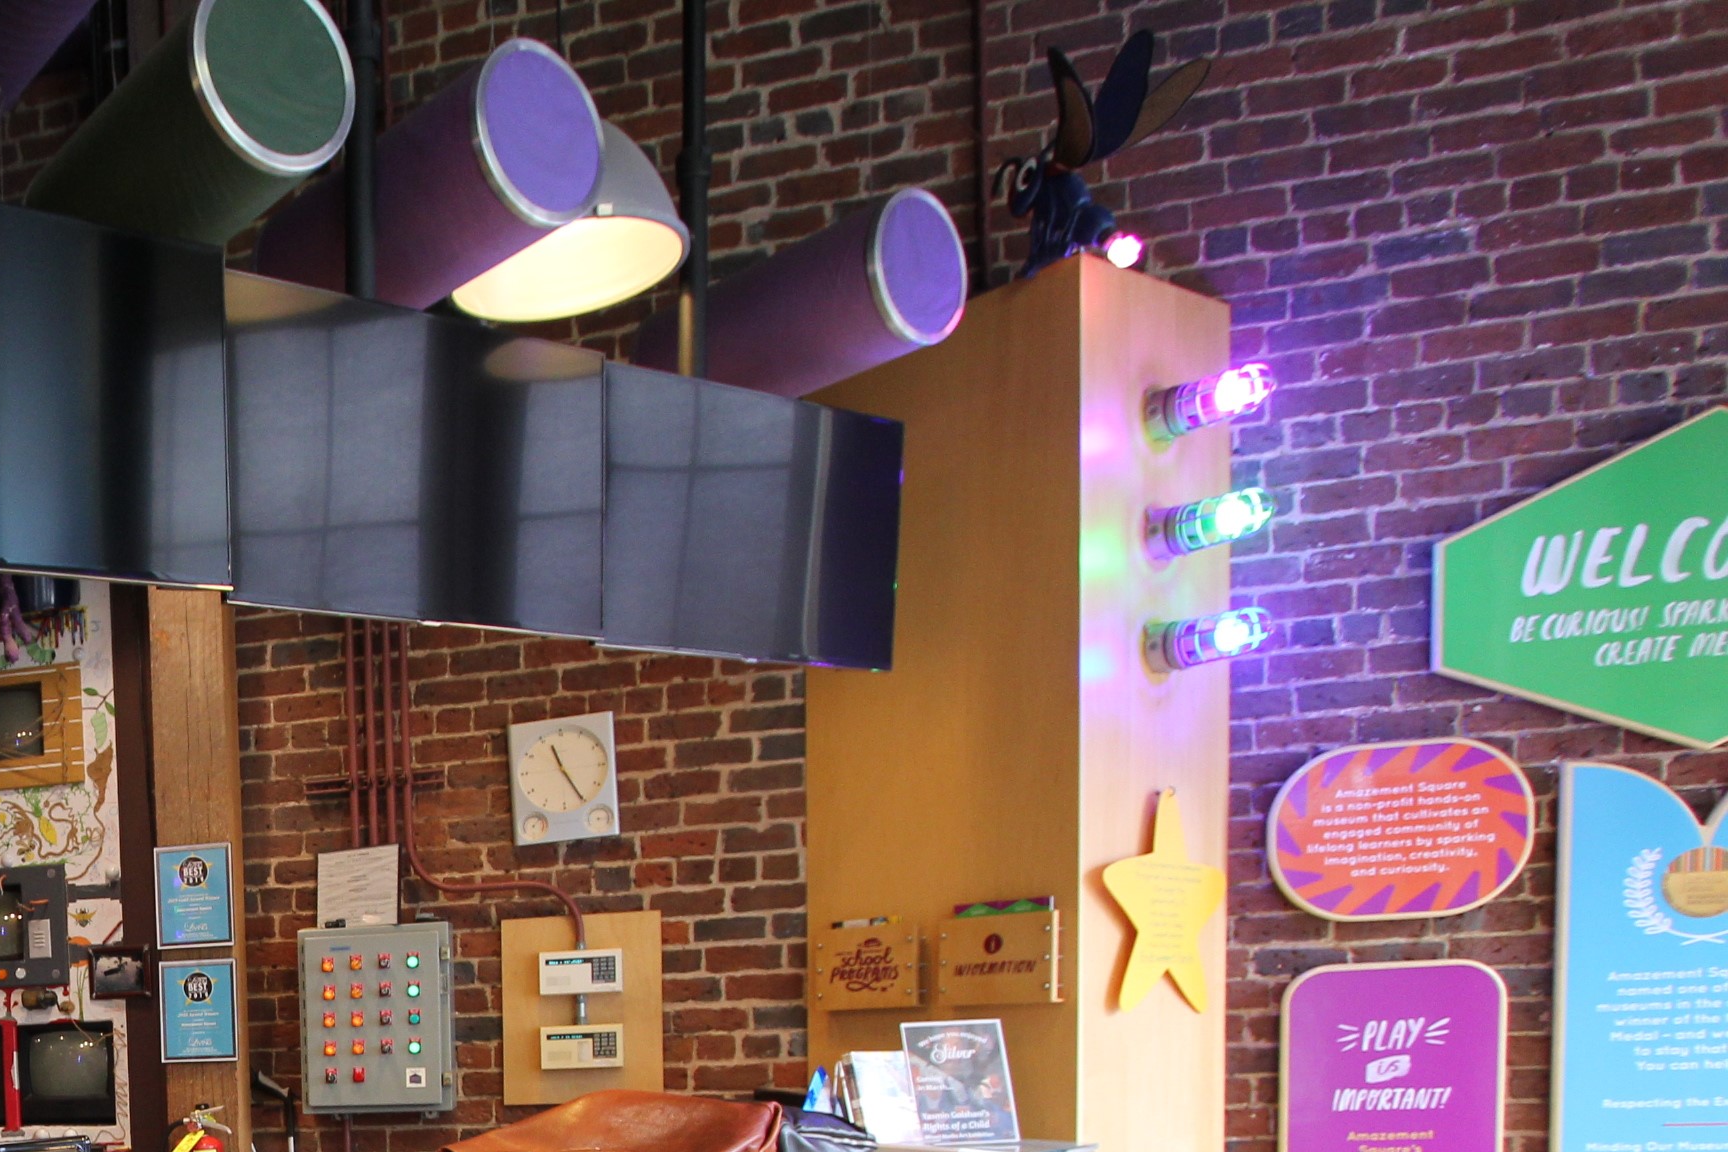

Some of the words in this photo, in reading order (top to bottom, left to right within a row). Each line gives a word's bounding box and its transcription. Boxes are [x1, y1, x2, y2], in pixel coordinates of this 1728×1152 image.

[1510, 615, 1540, 643] BE
[1541, 605, 1650, 641] CURIOUS!
[1594, 634, 1683, 668] CREATE
[1335, 783, 1414, 799] Amazement
[1418, 780, 1467, 793] Square
[1321, 804, 1332, 813] is
[1334, 804, 1344, 812] a
[1347, 797, 1414, 811] non-profit
[1418, 793, 1481, 805] hands-on
[1312, 814, 1368, 827] museum
[1372, 811, 1399, 822] that
[1403, 807, 1468, 821] cultivates
[1471, 805, 1489, 814] an
[1323, 827, 1382, 840] engaged
[1386, 821, 1460, 835] community
[1464, 818, 1480, 829] of
[1306, 841, 1354, 854] lifelong
[1358, 837, 1412, 850] learners
[1416, 836, 1432, 847] by
[1437, 831, 1496, 846] sparking
[1324, 850, 1406, 866] imagination,
[183, 867, 202, 876] BEST
[1350, 867, 1376, 877] and
[841, 946, 893, 967] school
[829, 965, 899, 984] PROGRAMS
[953, 960, 1037, 977] INFORMATION
[1607, 968, 1702, 981] Amazement
[188, 983, 207, 992] BEST
[1677, 985, 1708, 994] one
[1694, 998, 1722, 1009] the
[1673, 1014, 1690, 1024] of
[1694, 1013, 1721, 1024] the
[1362, 1017, 1426, 1052] PLAY
[1609, 1031, 1659, 1041] Medal
[1675, 1029, 1706, 1040] and
[930, 1043, 976, 1064] Silver
[1633, 1046, 1651, 1056] to
[1655, 1046, 1689, 1057] stay
[1376, 1060, 1401, 1075] is
[1635, 1060, 1665, 1071] You
[1669, 1061, 1699, 1070] can
[1331, 1087, 1452, 1112] IMPORTANT!
[1686, 1097, 1710, 1107] the
[923, 1122, 949, 1133] Rights
[951, 1121, 960, 1130] of
[969, 1119, 990, 1129] Child
[1347, 1130, 1434, 1141] Amazement
